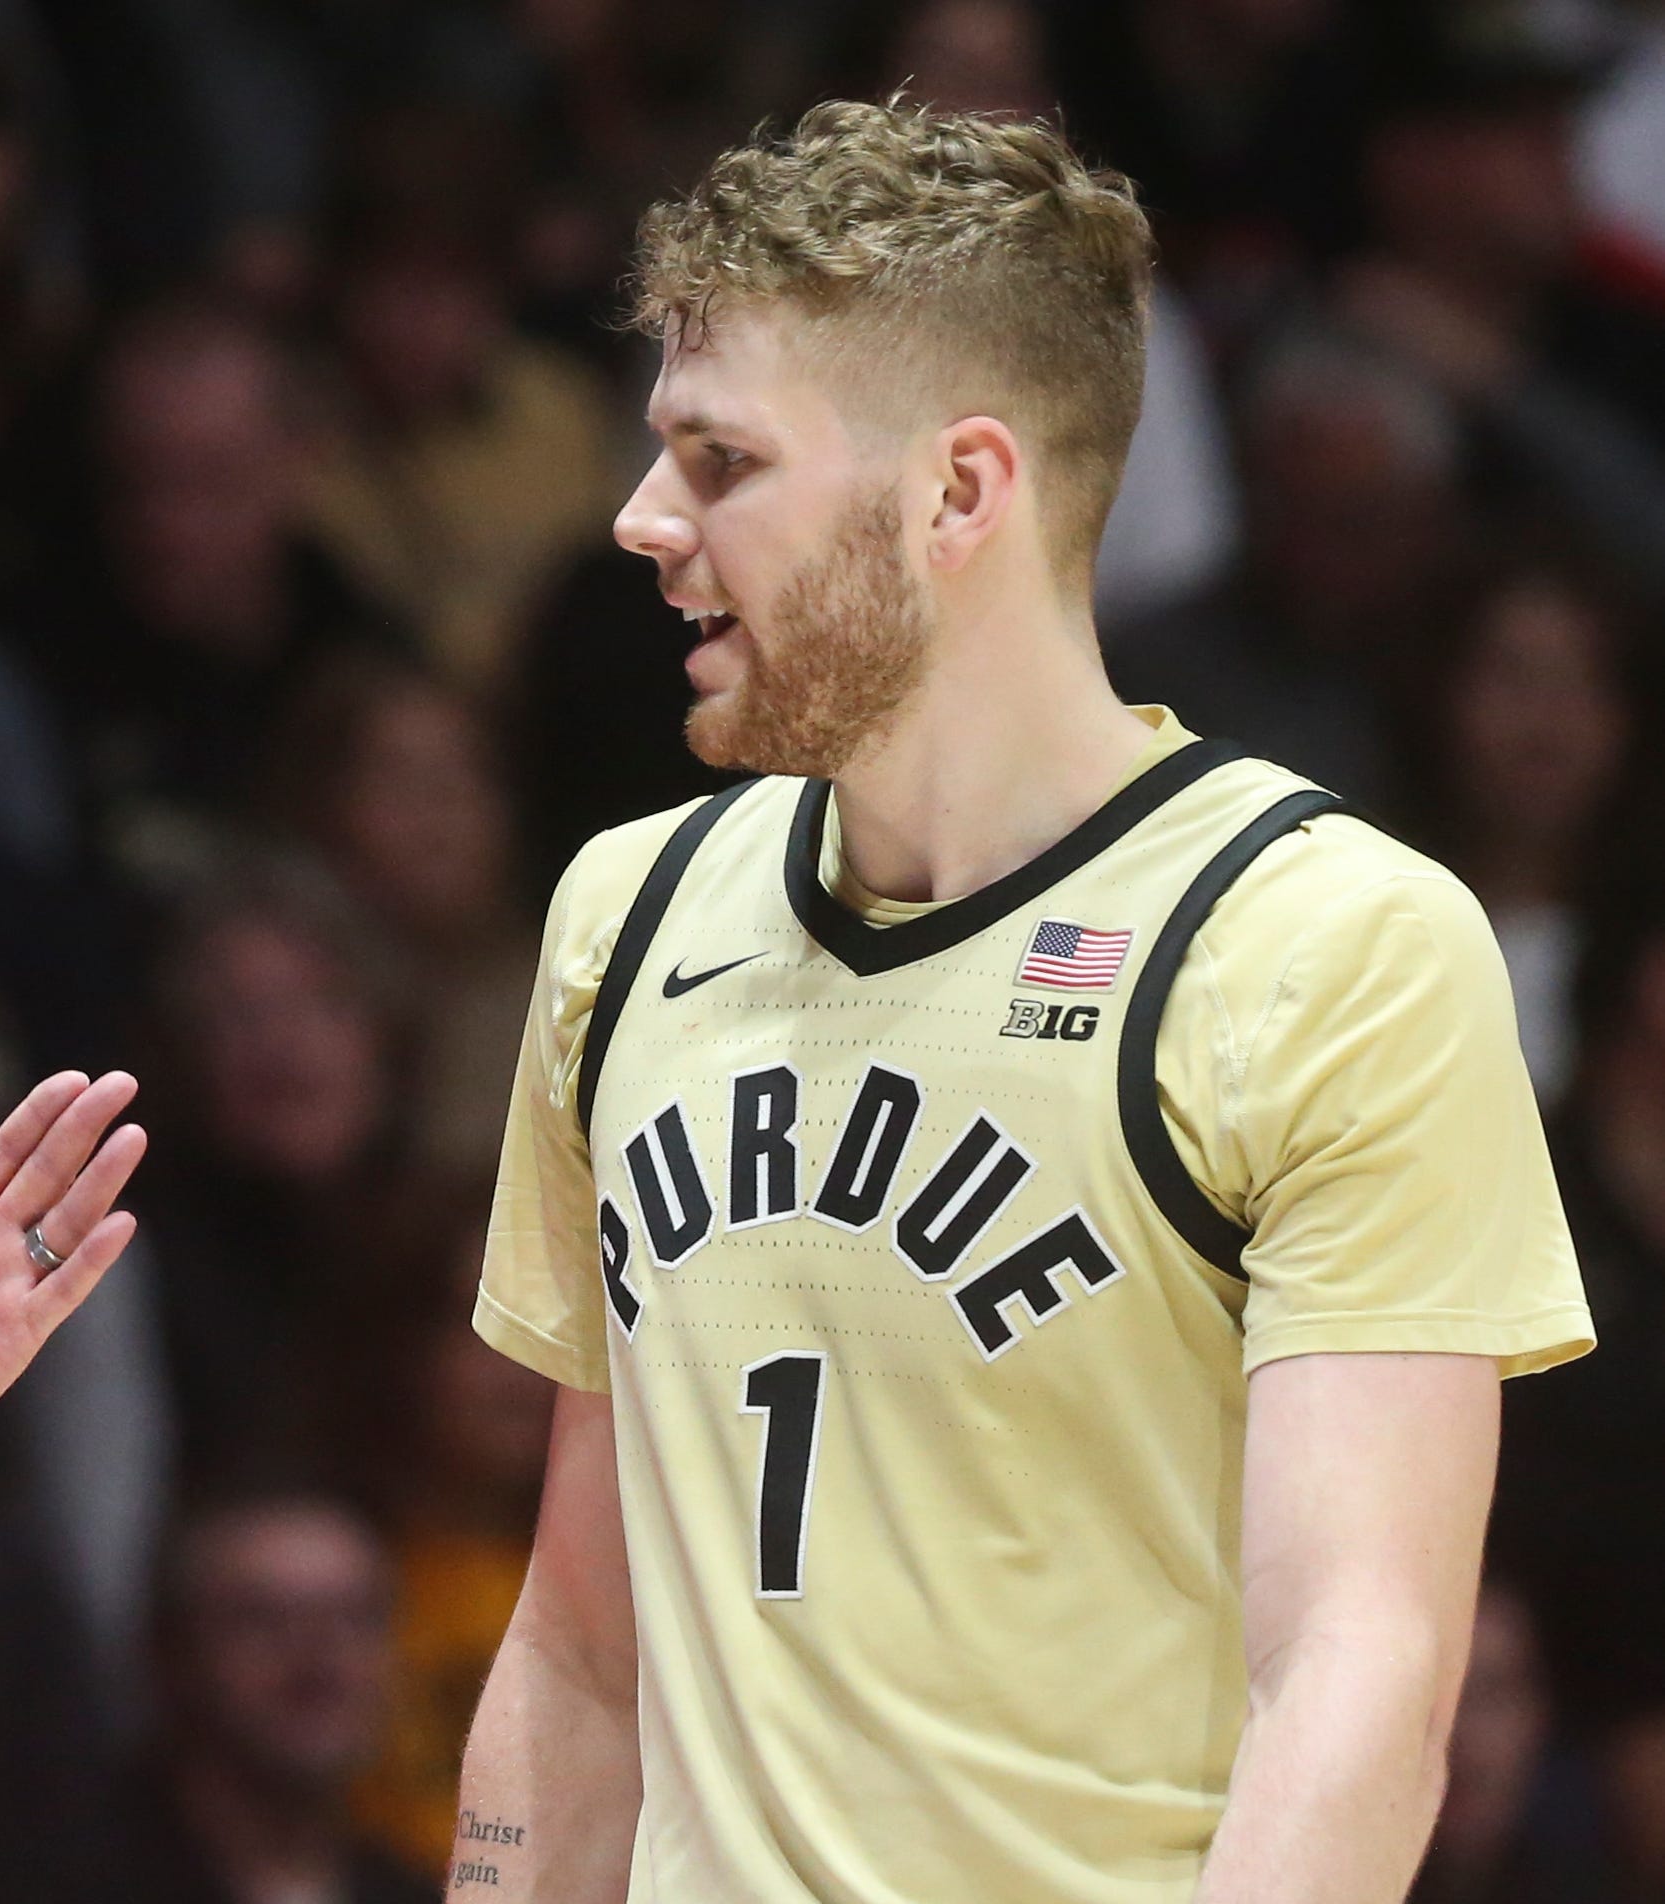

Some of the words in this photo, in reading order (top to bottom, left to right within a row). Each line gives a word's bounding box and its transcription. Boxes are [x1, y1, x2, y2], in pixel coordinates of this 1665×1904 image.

[598, 1057, 1127, 1363] PURDUE
[738, 1349, 828, 1600] 1
[449, 1856, 498, 1888] gain
[459, 1810, 525, 1846] Christ
